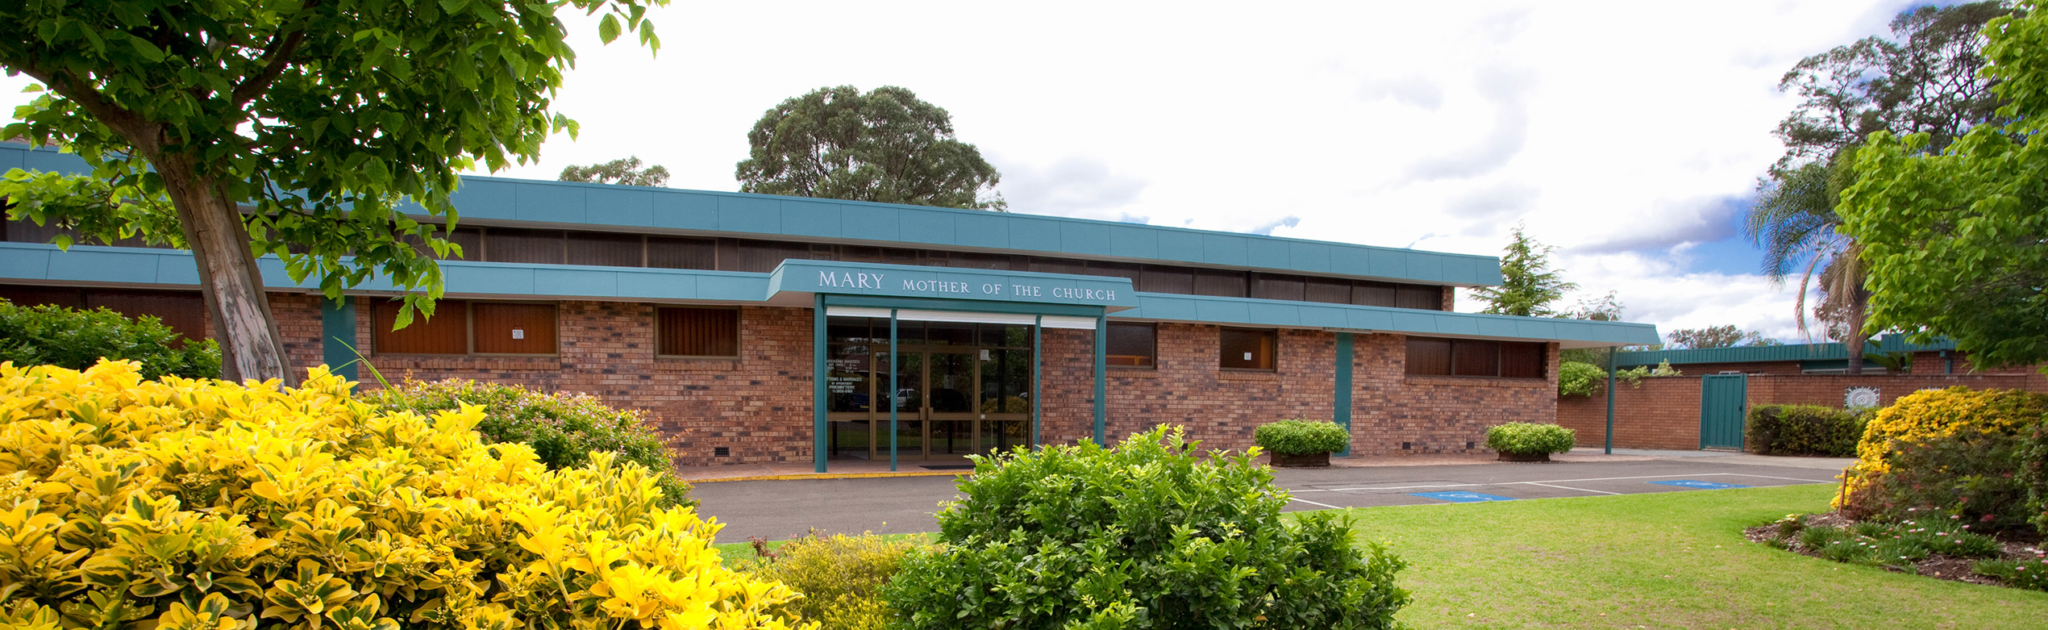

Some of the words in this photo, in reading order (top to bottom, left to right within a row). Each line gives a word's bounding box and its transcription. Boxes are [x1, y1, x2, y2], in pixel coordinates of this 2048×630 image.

[819, 270, 885, 289] MARY
[902, 279, 970, 293] MOTHER
[982, 283, 1002, 295] OF
[1013, 284, 1042, 297] THE
[1052, 287, 1116, 301] CHURCH
